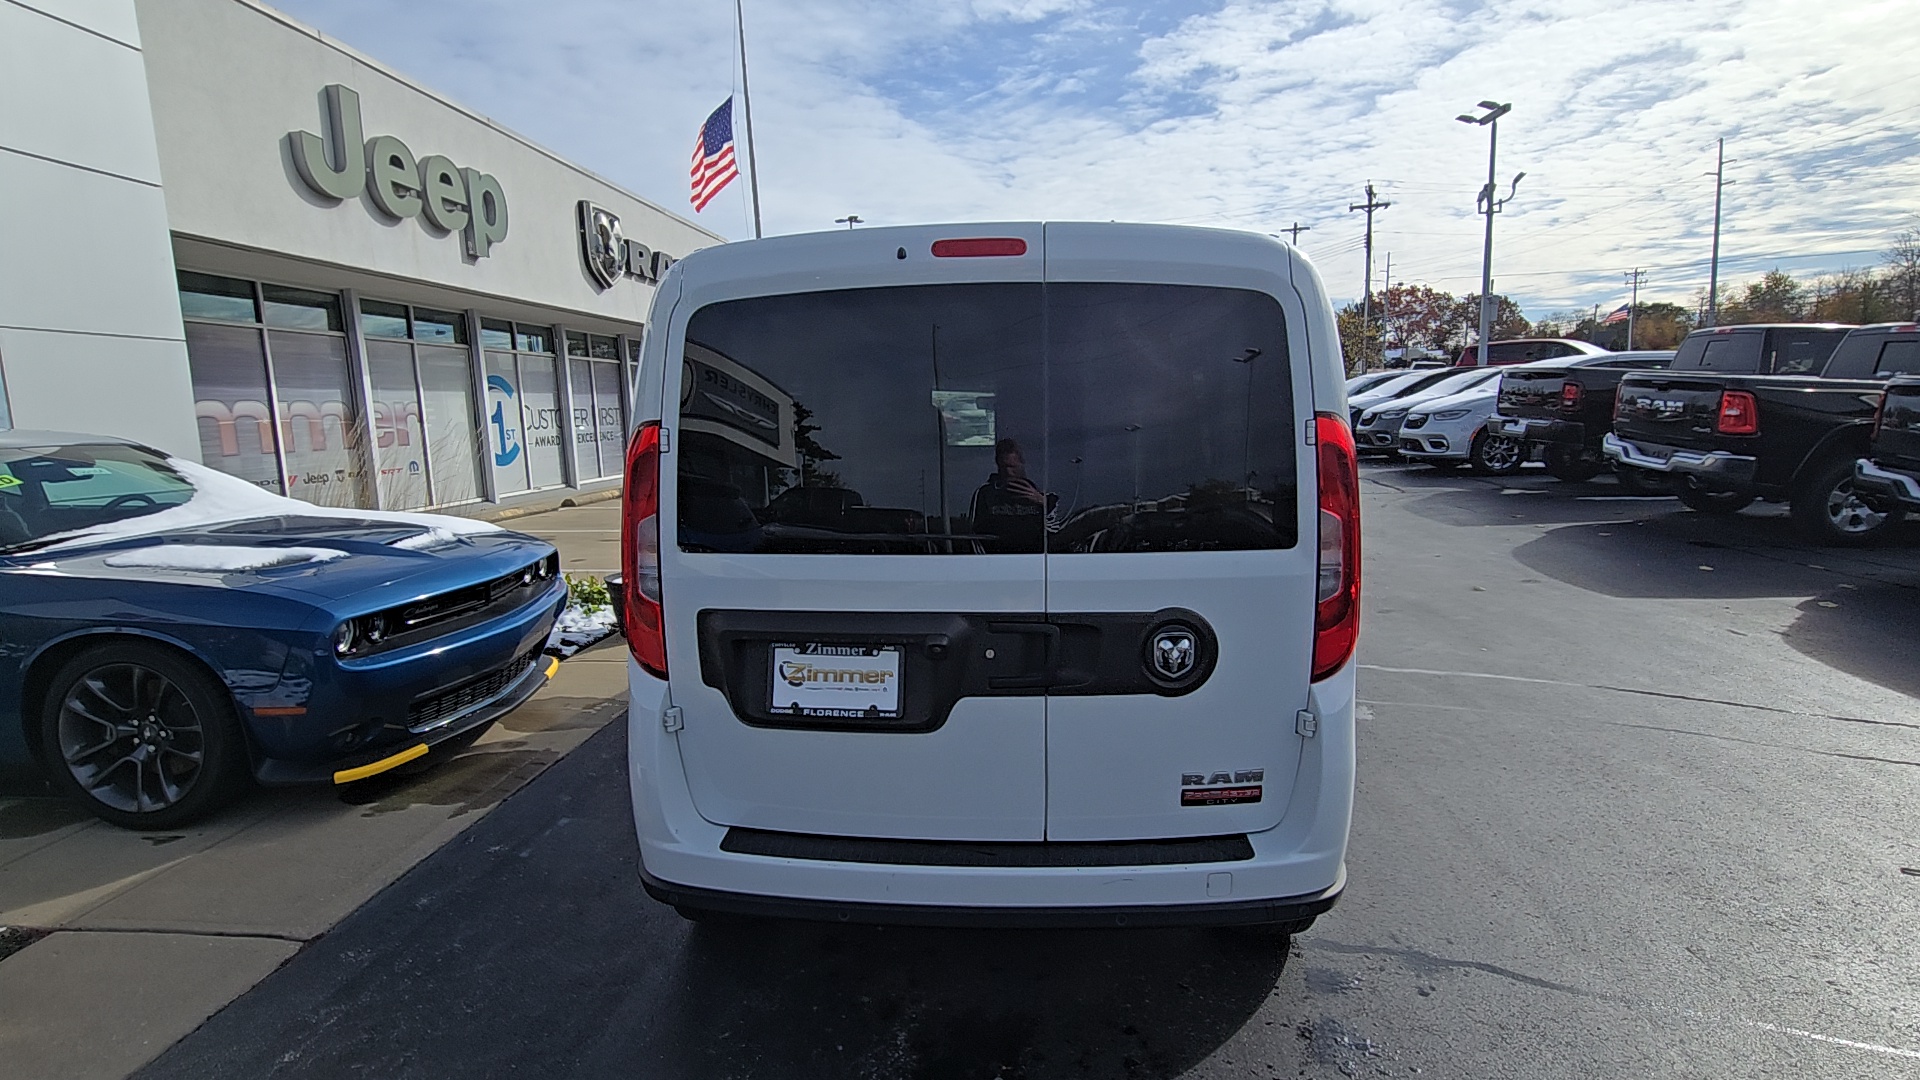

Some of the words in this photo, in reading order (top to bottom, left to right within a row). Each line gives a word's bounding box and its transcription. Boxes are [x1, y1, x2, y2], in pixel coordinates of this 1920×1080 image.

[284, 83, 509, 260] Jeep
[1636, 398, 1685, 412] RAM
[524, 404, 589, 431] CUSTOER
[534, 434, 561, 448] AWARD
[302, 472, 330, 485] Jeep
[381, 467, 403, 475] SRT
[806, 643, 866, 656] Zimmer
[784, 662, 894, 685] Zimmer
[803, 708, 865, 718] FLORENCE
[1181, 768, 1264, 786] RAM
